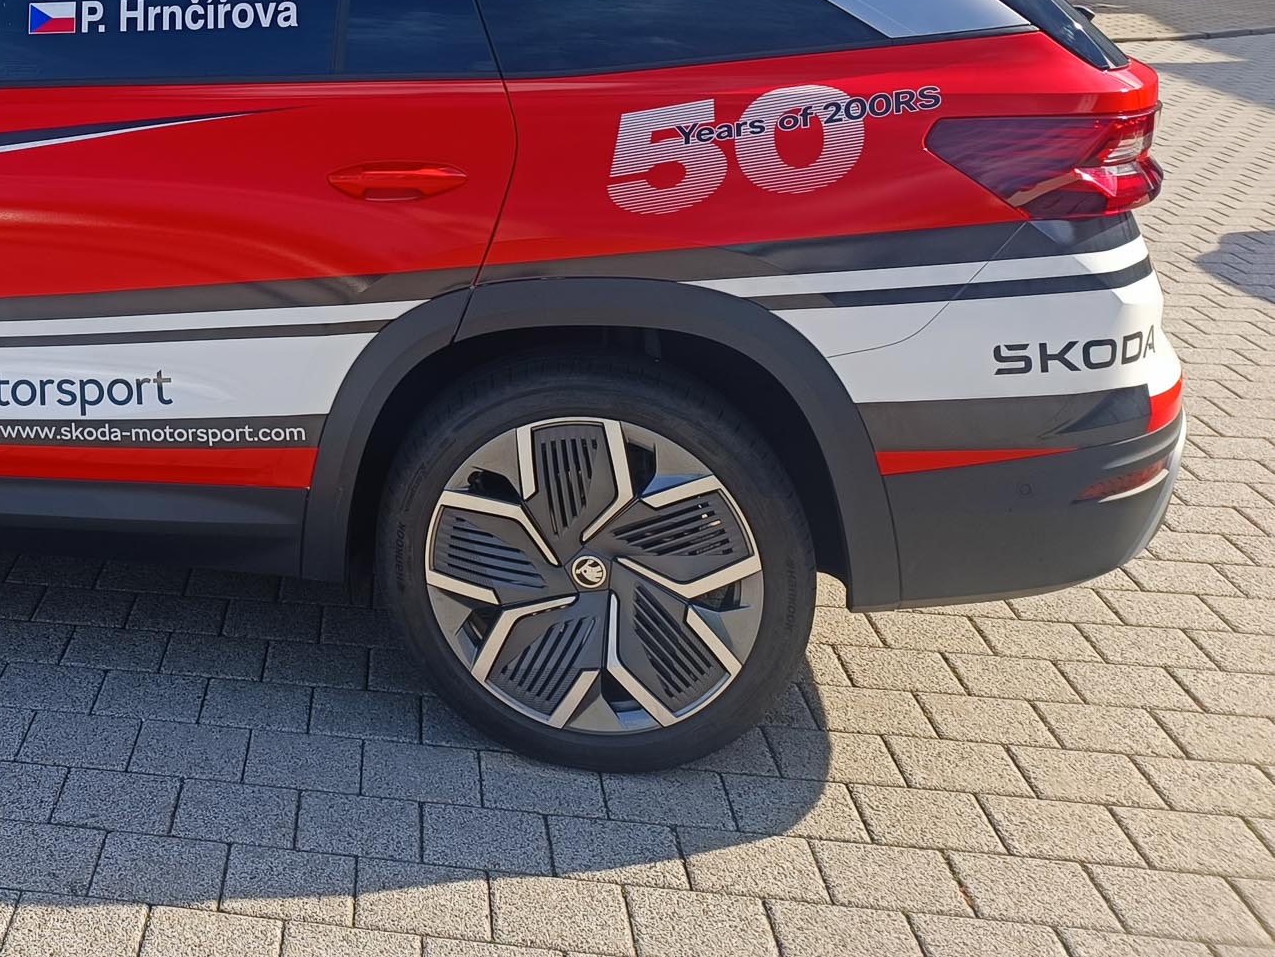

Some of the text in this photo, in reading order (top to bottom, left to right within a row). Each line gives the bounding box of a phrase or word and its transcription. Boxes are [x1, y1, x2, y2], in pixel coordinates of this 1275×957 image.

[81, 0, 106, 33] P.
[675, 85, 942, 145] Years of 200RS
[606, 84, 865, 215] 50
